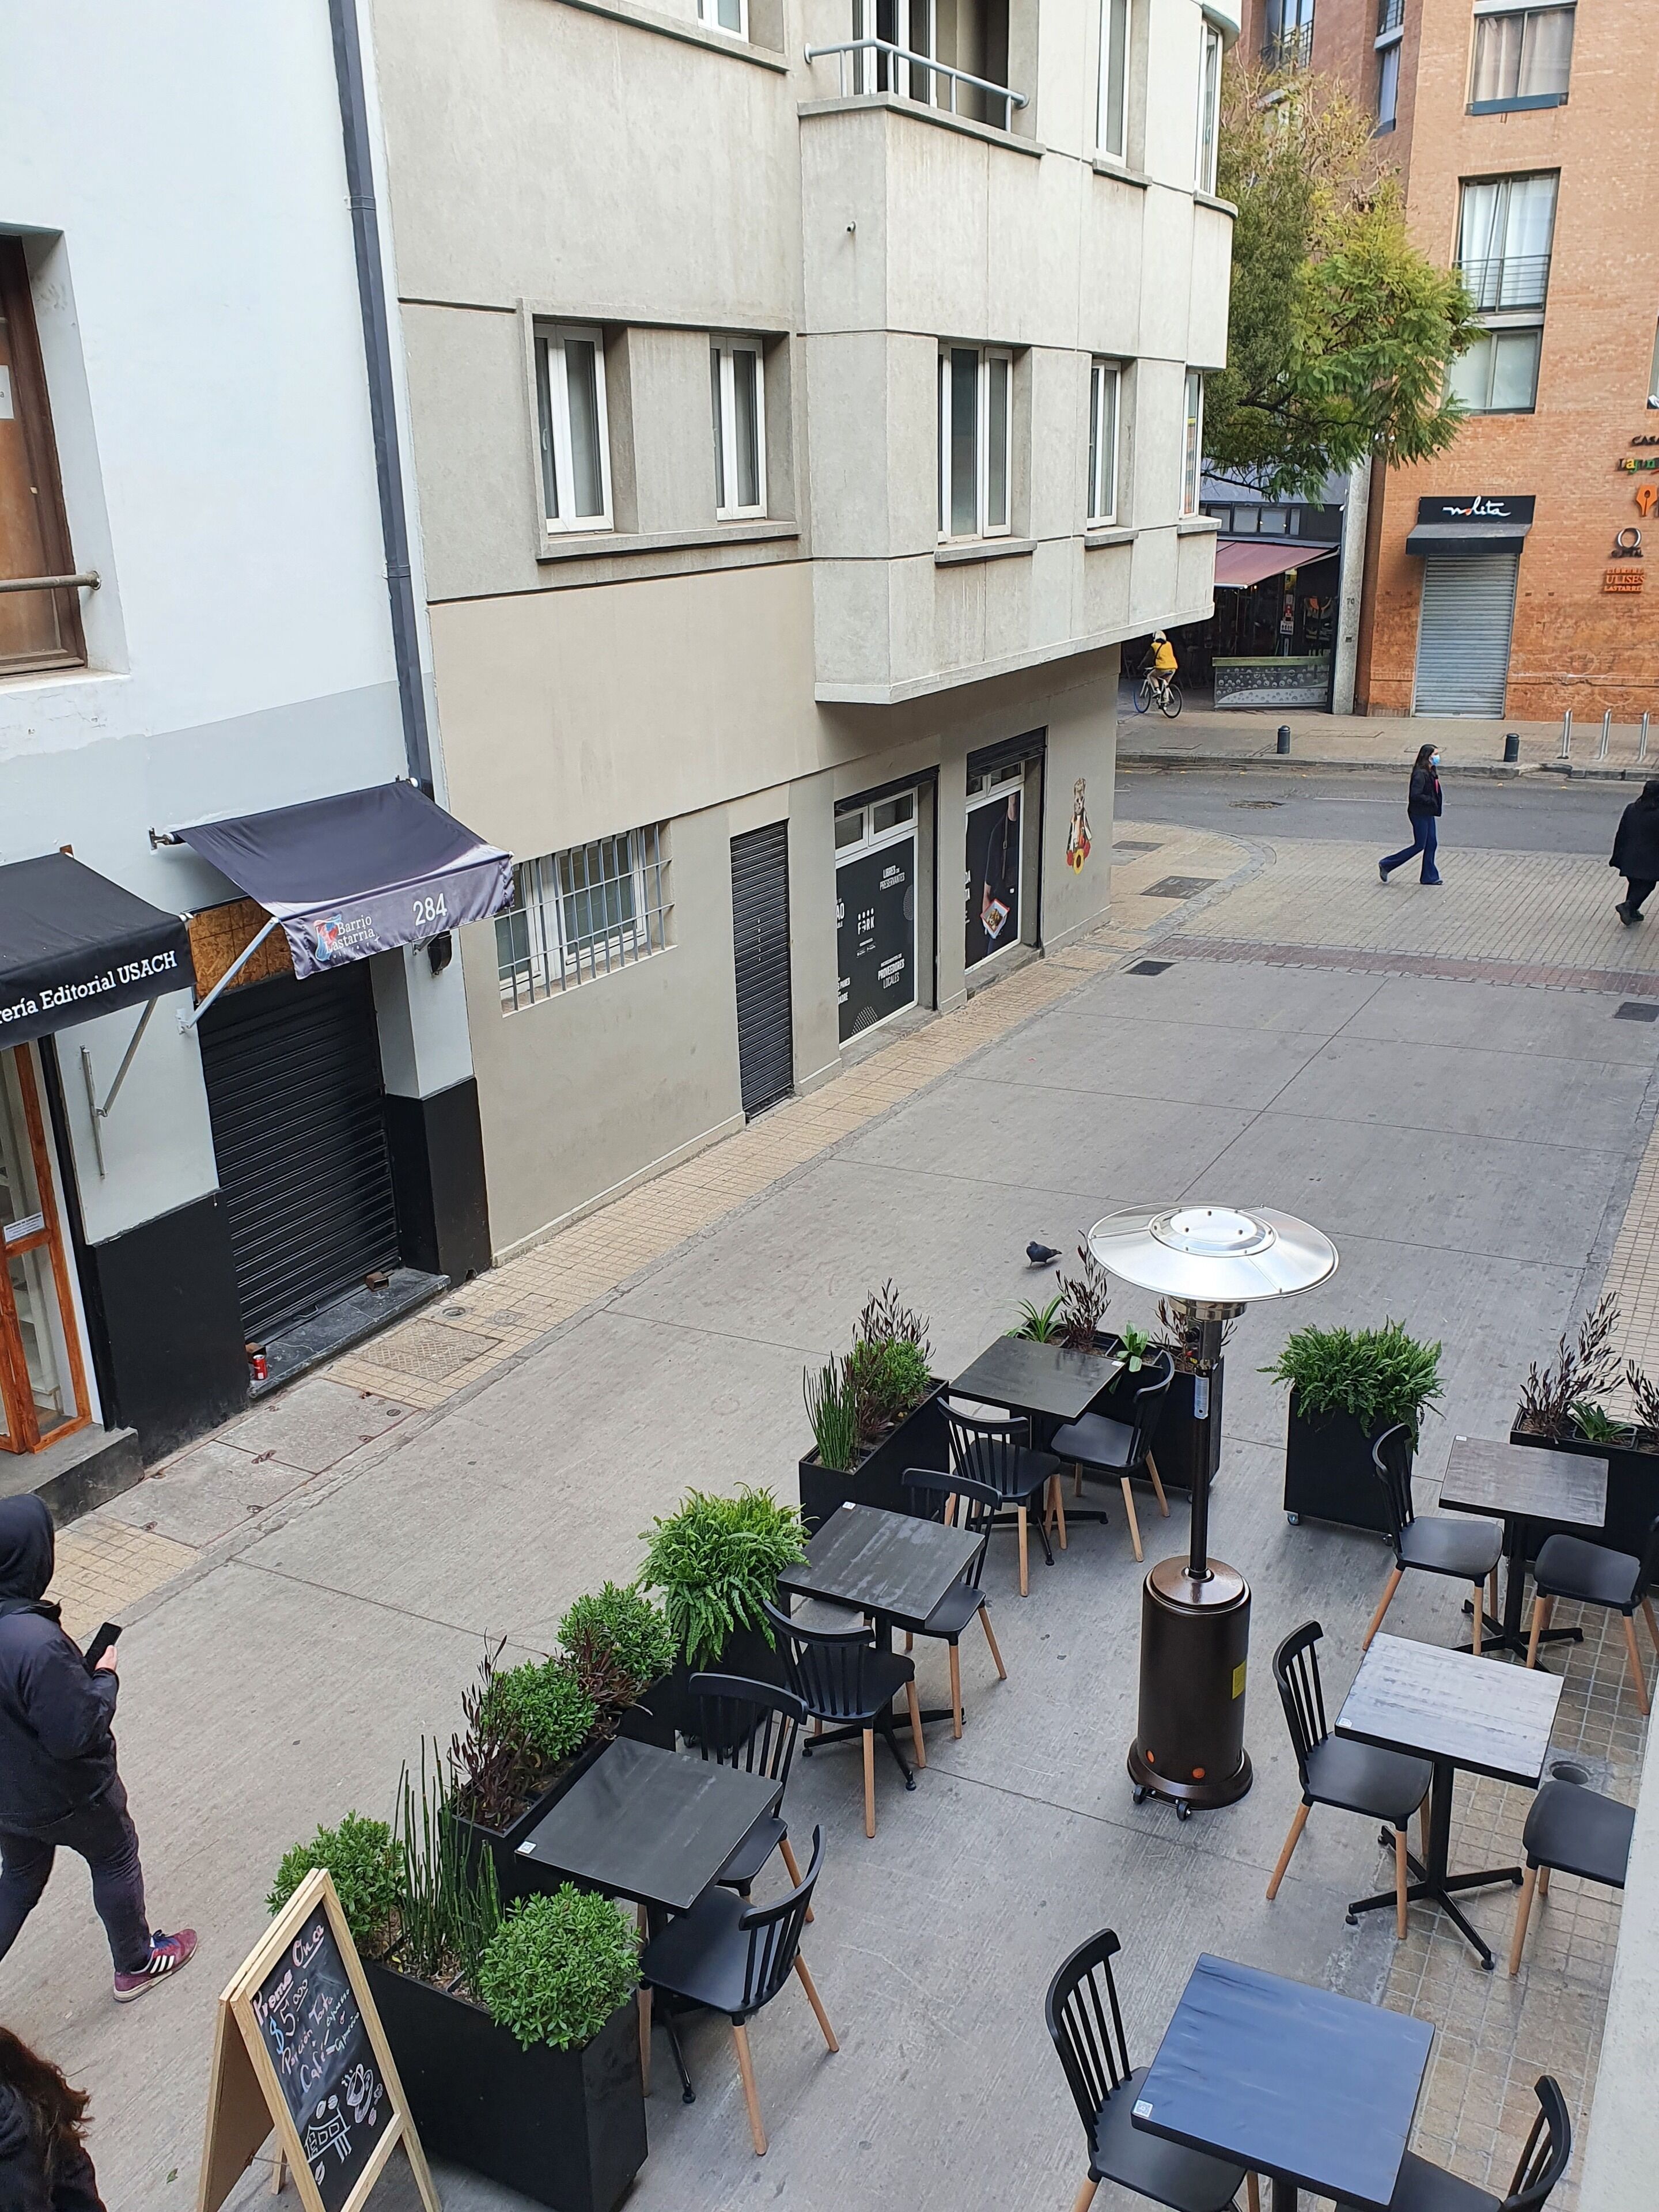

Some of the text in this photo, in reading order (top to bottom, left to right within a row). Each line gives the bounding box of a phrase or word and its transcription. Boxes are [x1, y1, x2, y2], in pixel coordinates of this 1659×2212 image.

[1442, 495, 1512, 517] nolita
[1606, 575, 1645, 584] ULISES
[412, 893, 448, 926] 284
[337, 914, 372, 936] Barrio
[324, 925, 376, 955] Lastarria
[39, 971, 116, 1010] Editorial
[116, 950, 178, 984] USACH
[883, 971, 900, 990] LOCALES
